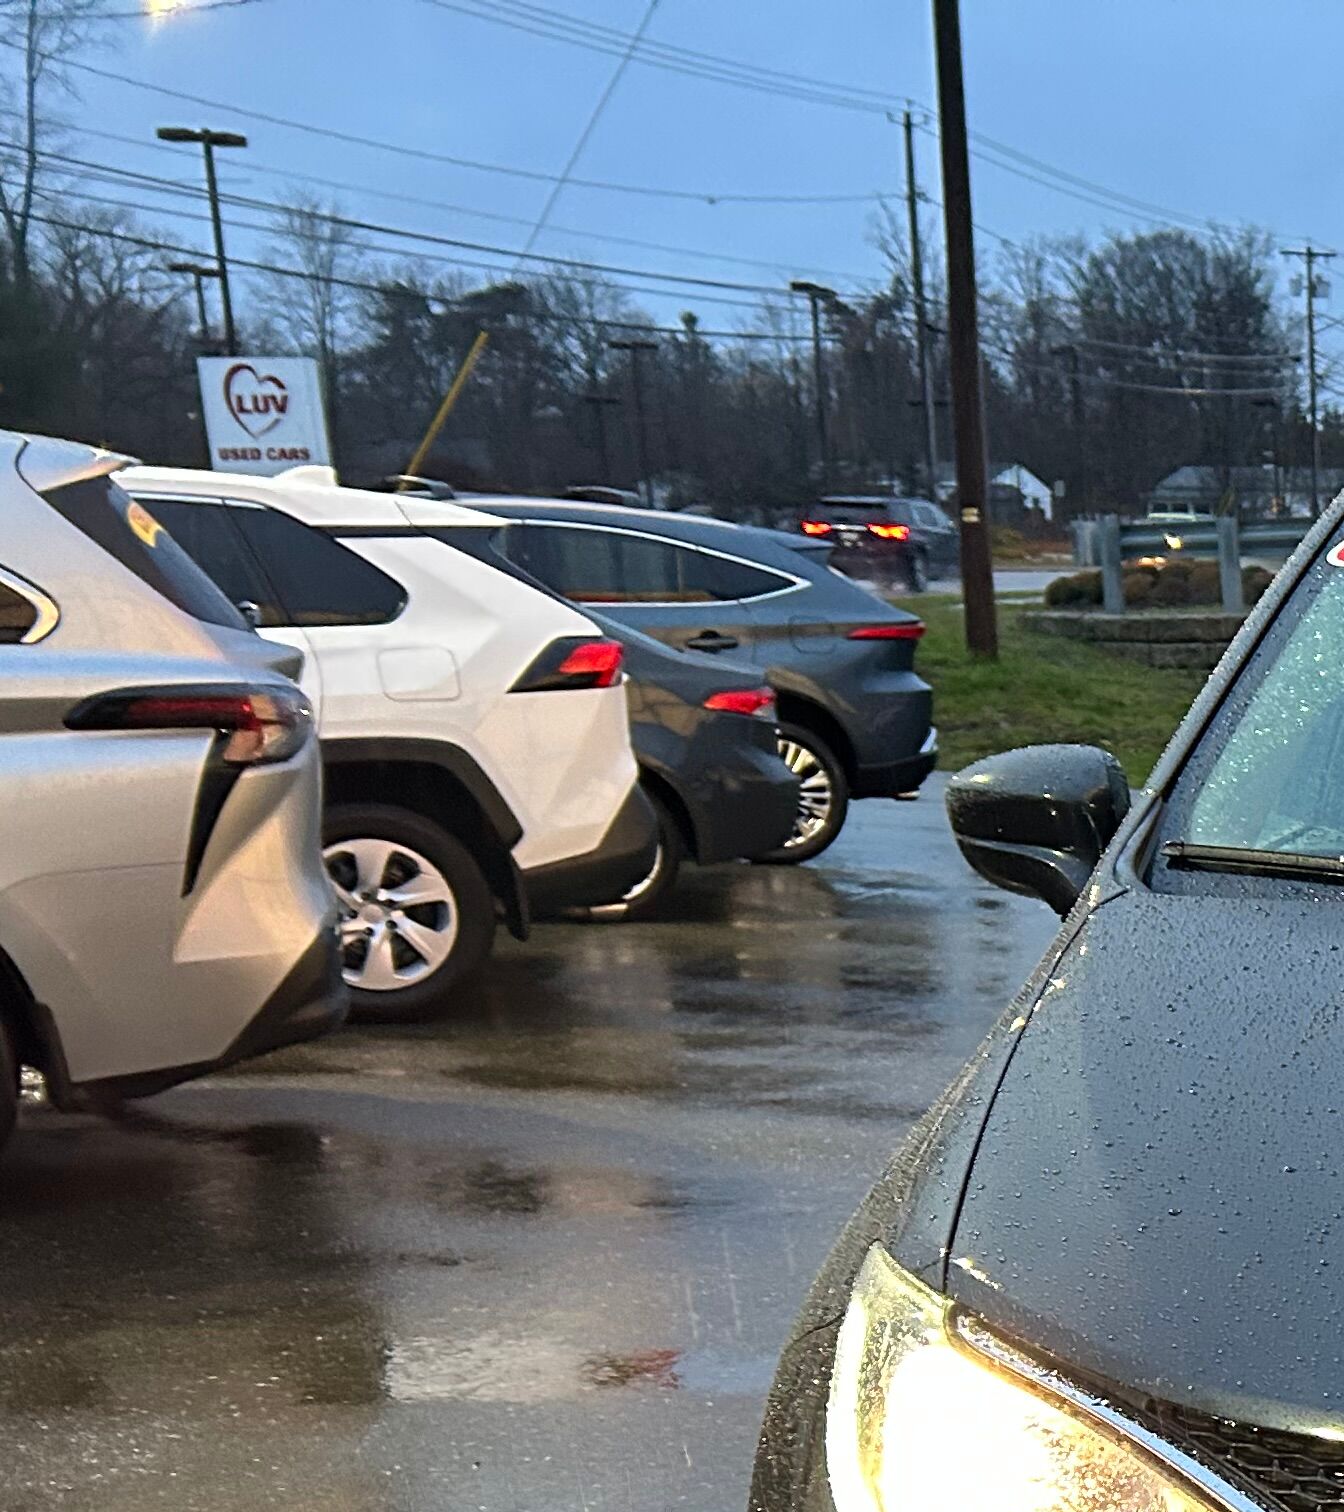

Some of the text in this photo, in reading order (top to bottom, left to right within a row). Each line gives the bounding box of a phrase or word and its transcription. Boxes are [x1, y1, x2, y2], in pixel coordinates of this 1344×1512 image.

[236, 395, 288, 414] LUV
[218, 447, 310, 461] USED CARS
